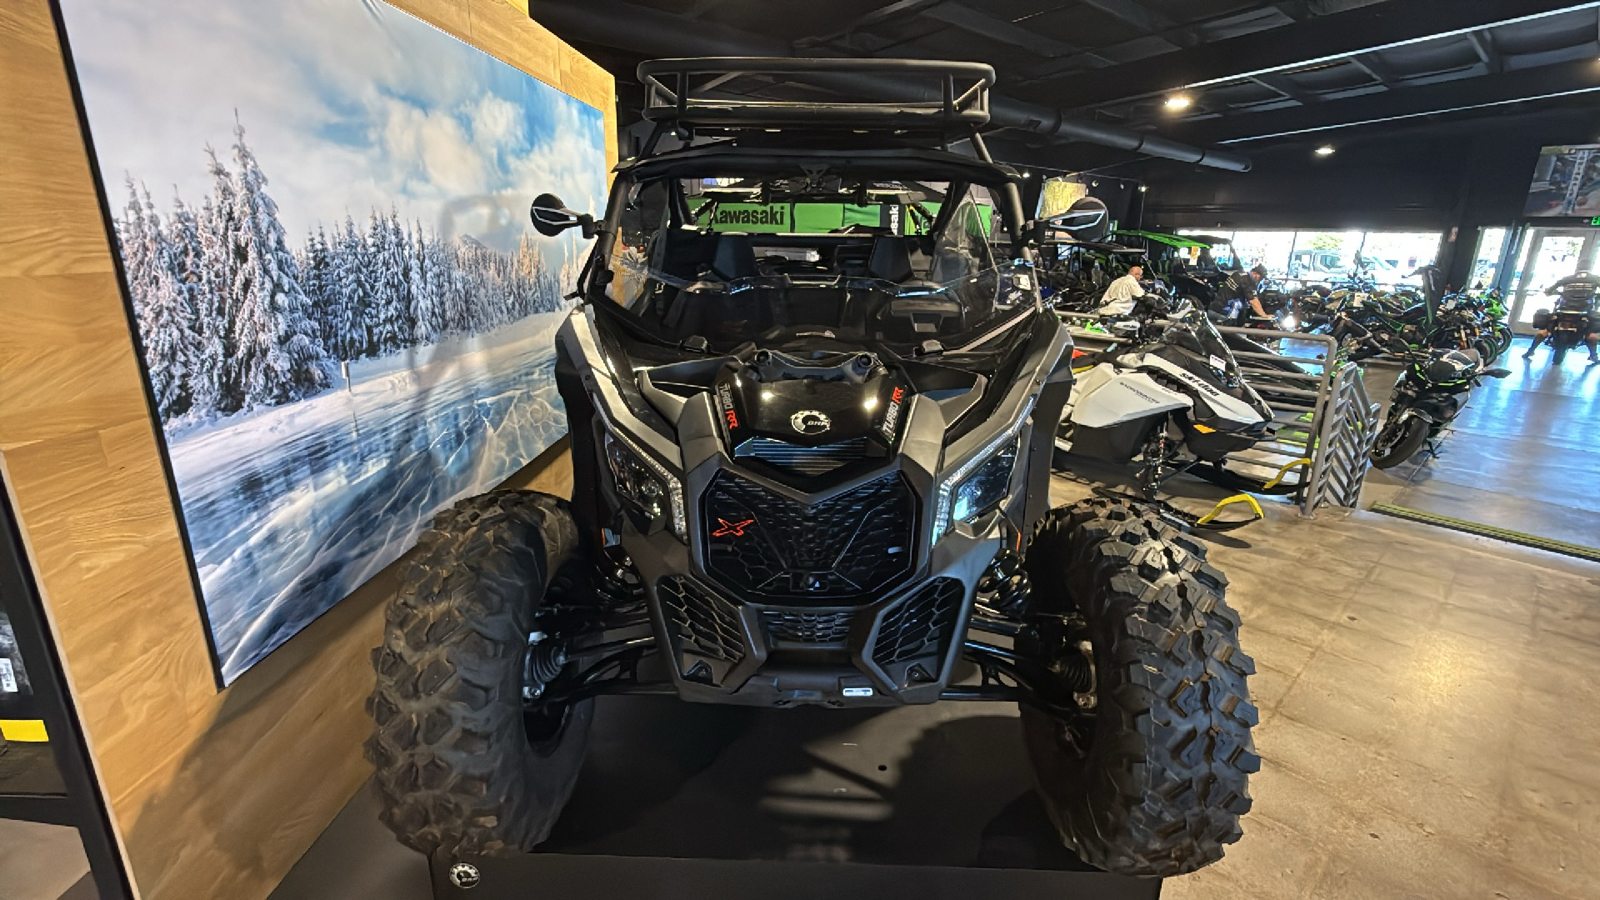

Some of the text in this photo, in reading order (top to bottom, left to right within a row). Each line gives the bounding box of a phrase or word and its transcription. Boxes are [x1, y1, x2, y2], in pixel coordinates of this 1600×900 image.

[719, 382, 739, 430] TURBO RR
[882, 386, 904, 434] TURBO RR
